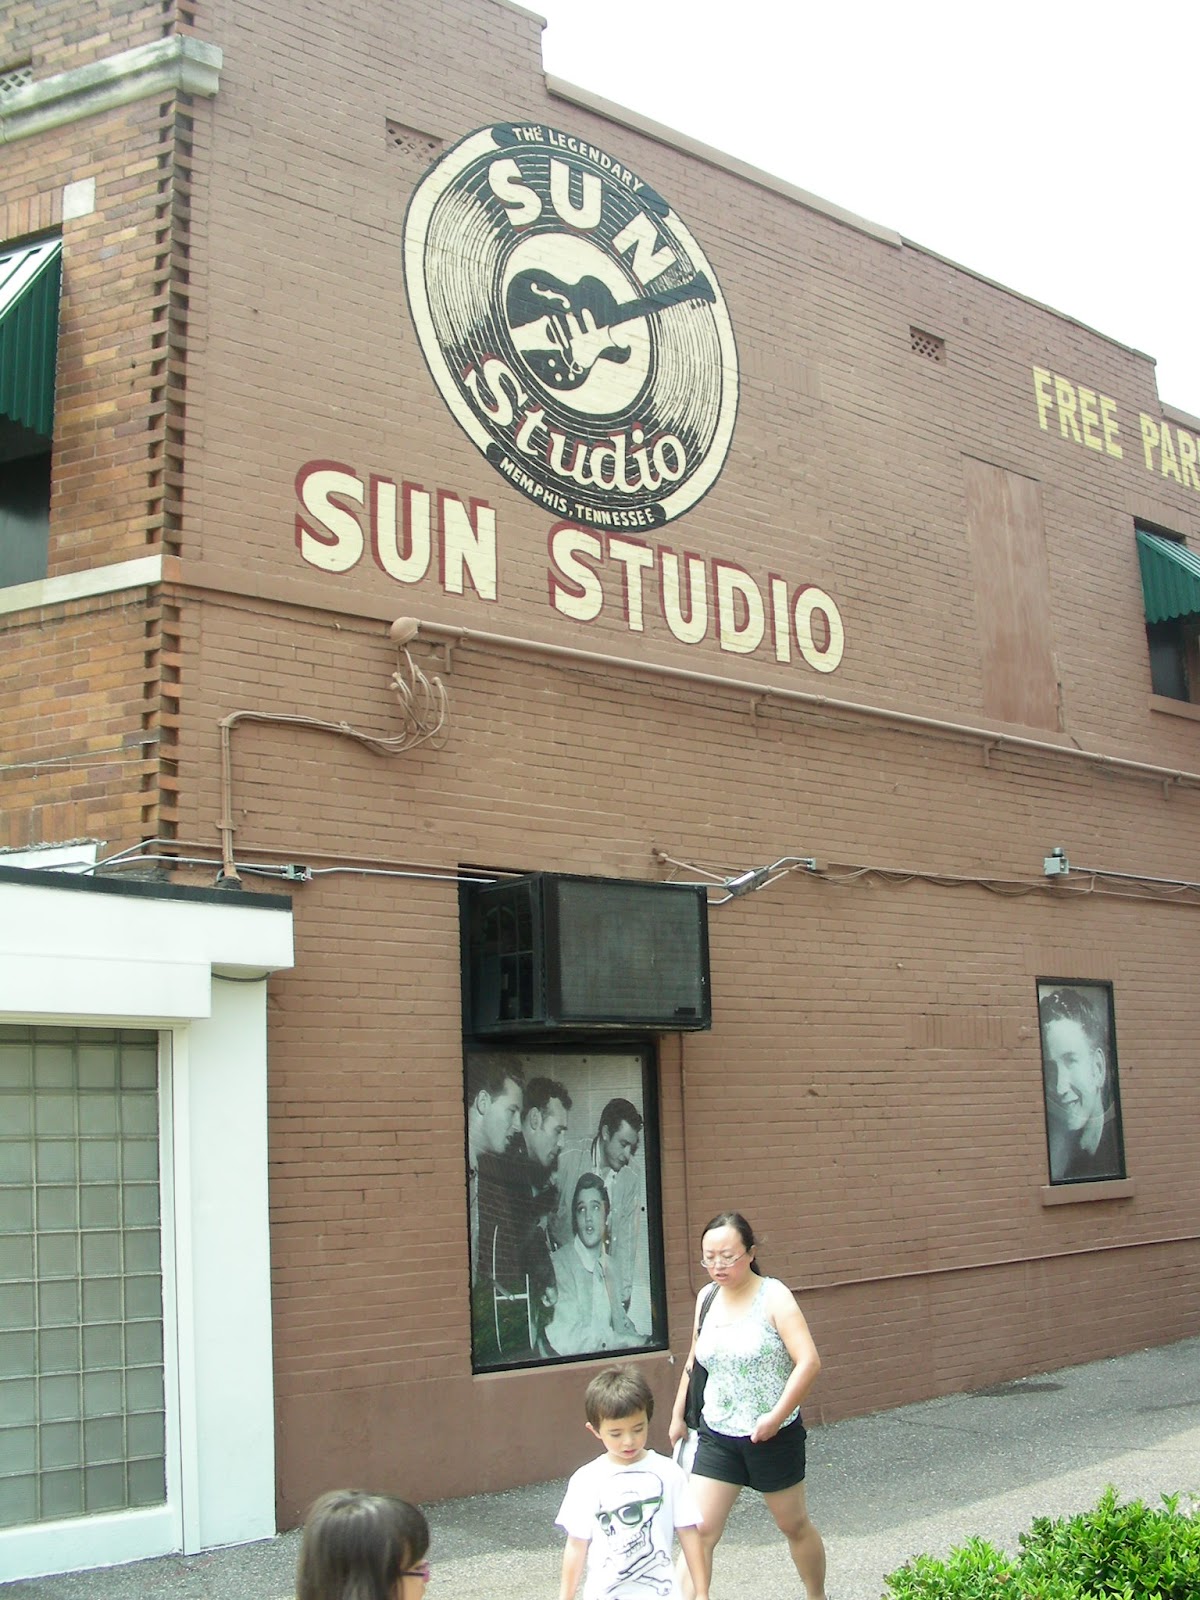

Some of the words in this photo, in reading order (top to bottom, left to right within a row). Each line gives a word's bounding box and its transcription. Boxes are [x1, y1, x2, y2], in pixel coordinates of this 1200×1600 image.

[488, 157, 679, 288] SUN
[512, 126, 544, 142] THE
[548, 129, 645, 193] LEGENDARY
[462, 354, 688, 494] Studio
[1033, 365, 1123, 460] FREE
[1139, 411, 1200, 492] PAR
[295, 459, 498, 601] SUN
[547, 519, 846, 675] STUDIO
[575, 503, 656, 528] TENNESSEE
